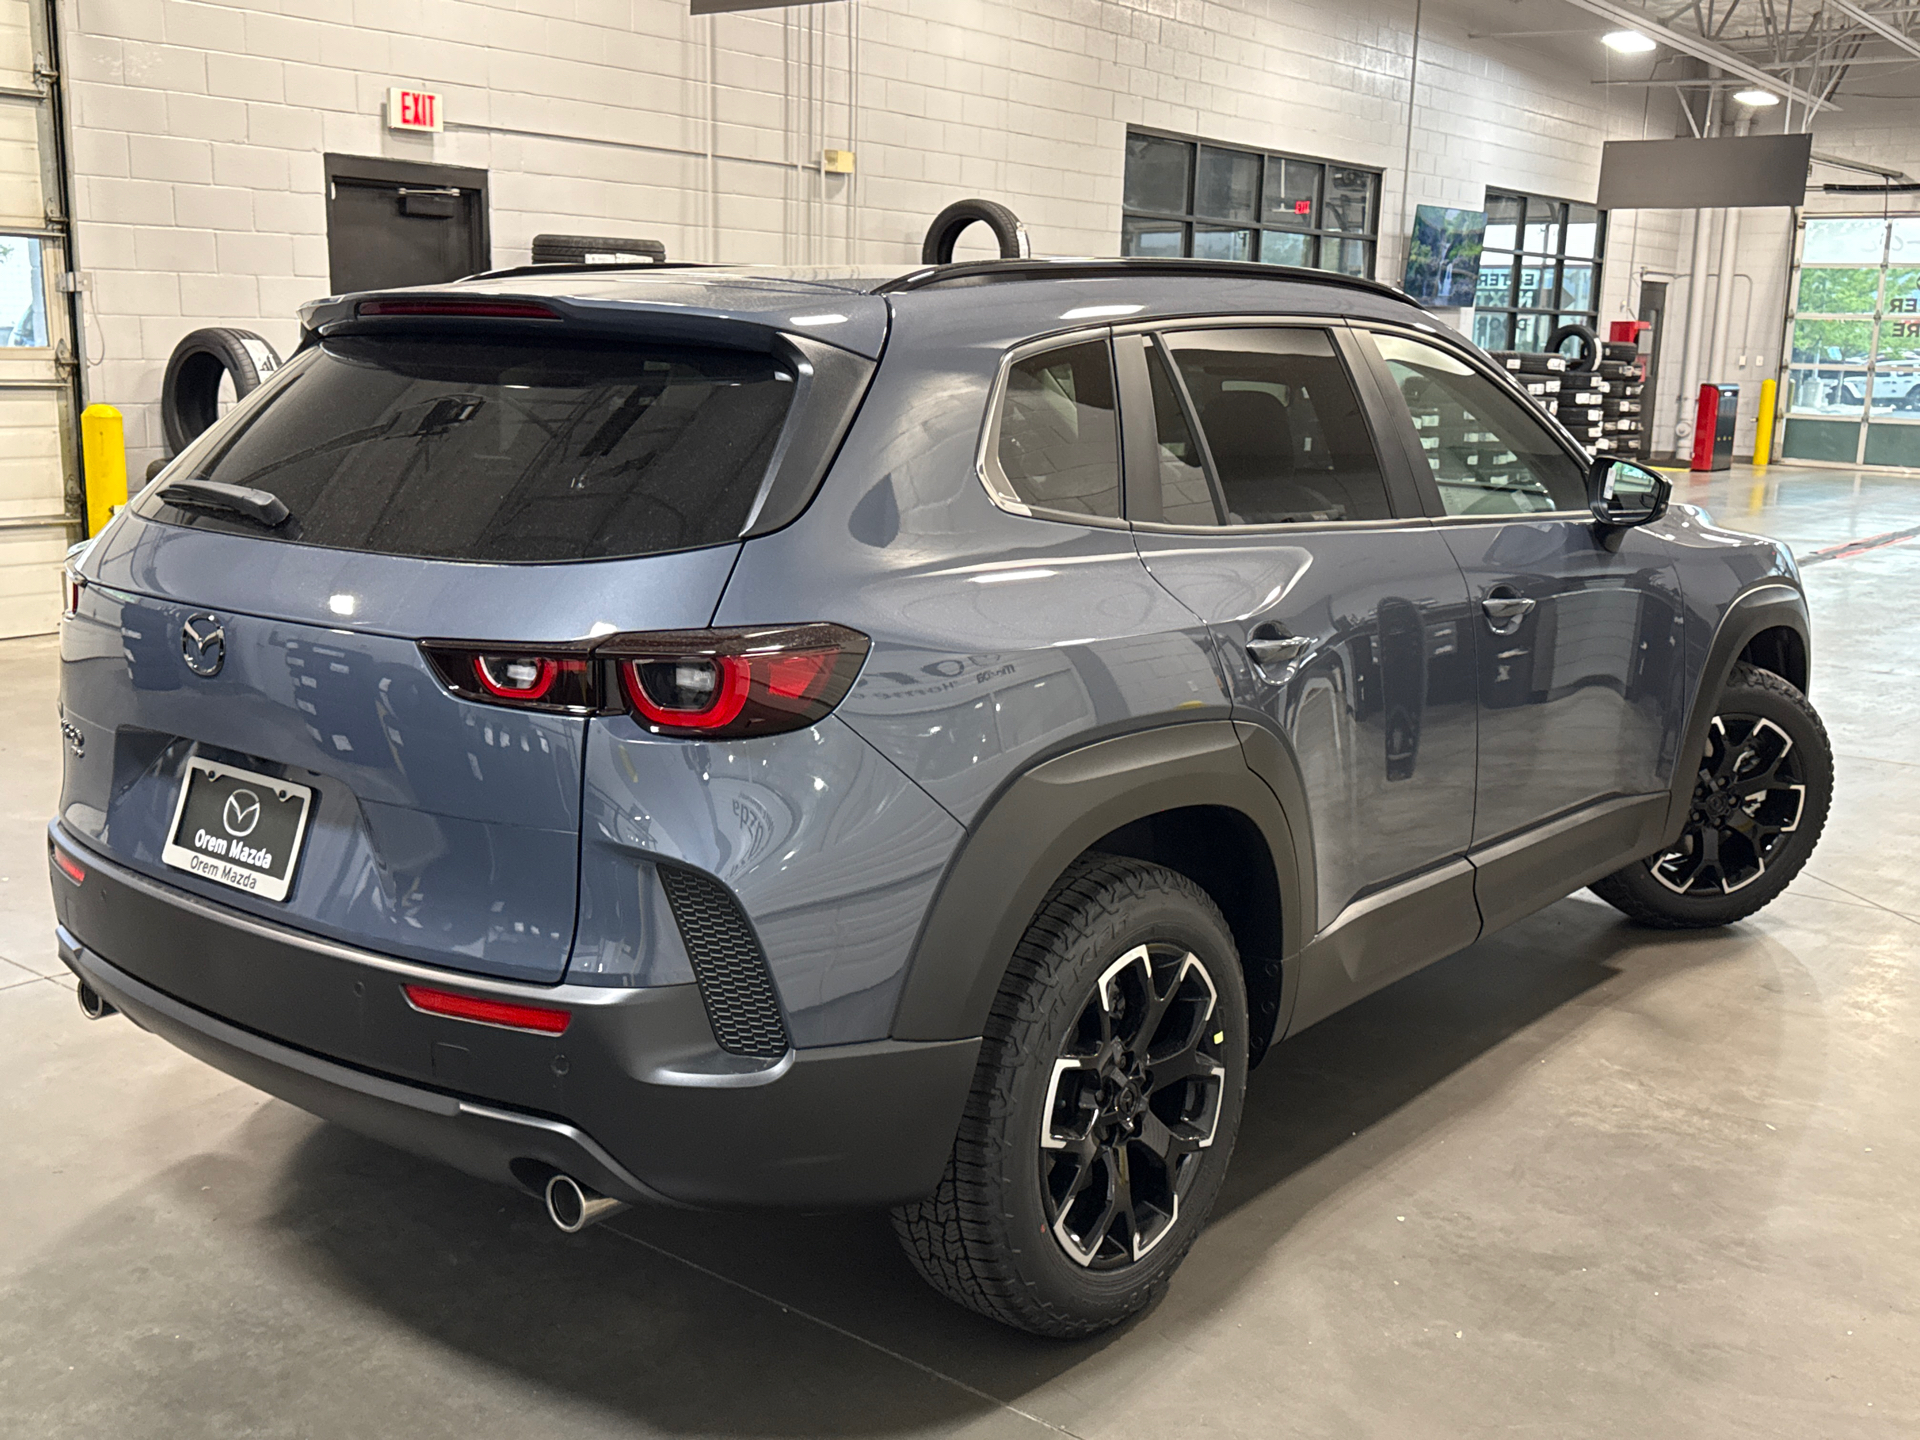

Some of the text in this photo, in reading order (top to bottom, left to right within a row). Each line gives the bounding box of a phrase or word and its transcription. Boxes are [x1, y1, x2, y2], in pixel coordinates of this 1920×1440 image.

[401, 91, 436, 127] EXIT
[194, 828, 273, 870] Orem Mazda
[190, 855, 257, 890] Orem Mazda
